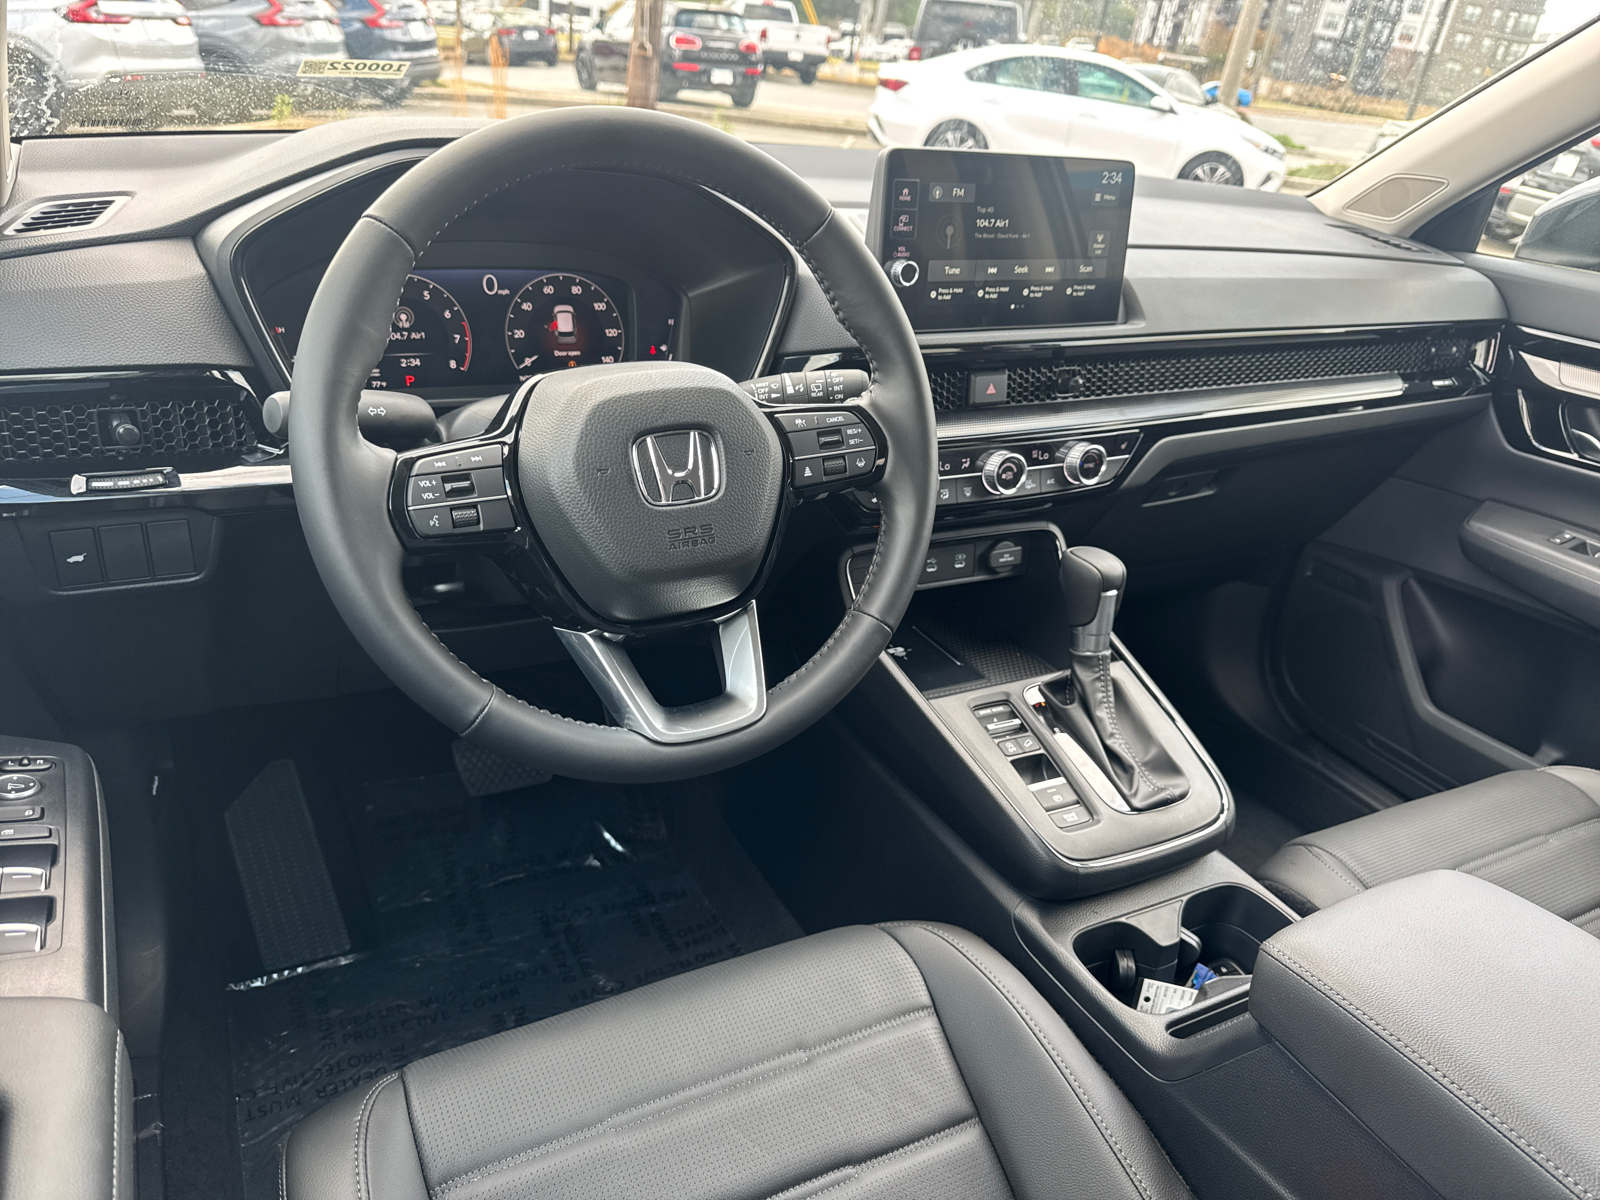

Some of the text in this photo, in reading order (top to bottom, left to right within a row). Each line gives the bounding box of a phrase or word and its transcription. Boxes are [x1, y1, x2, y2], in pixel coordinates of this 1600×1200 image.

[1102, 171, 1122, 184] 2:34
[952, 188, 965, 197] FM
[976, 218, 1009, 227] 104.7 Air1
[944, 266, 960, 274] Tune
[1014, 265, 1029, 274] Seek
[1079, 264, 1093, 272] Scan
[482, 274, 498, 295] 0
[543, 285, 554, 294] 60
[571, 285, 582, 294] 80
[423, 290, 430, 300] 5
[521, 302, 532, 311] 40
[593, 302, 606, 311] 100
[444, 309, 452, 318] 6
[390, 332, 408, 340] 04.7
[514, 330, 525, 338] 20
[604, 328, 618, 338] 120
[452, 334, 460, 344] 7
[400, 358, 420, 367] 2:34
[449, 360, 456, 369] 8
[405, 375, 415, 386] P
[1038, 450, 1049, 460] Lo
[940, 461, 950, 470] Lo
[667, 524, 714, 539] SRS
[669, 536, 716, 550] AIRBAG
[340, 1002, 406, 1030] DEALER
[342, 986, 522, 1044] PROTECTIVE COVER
